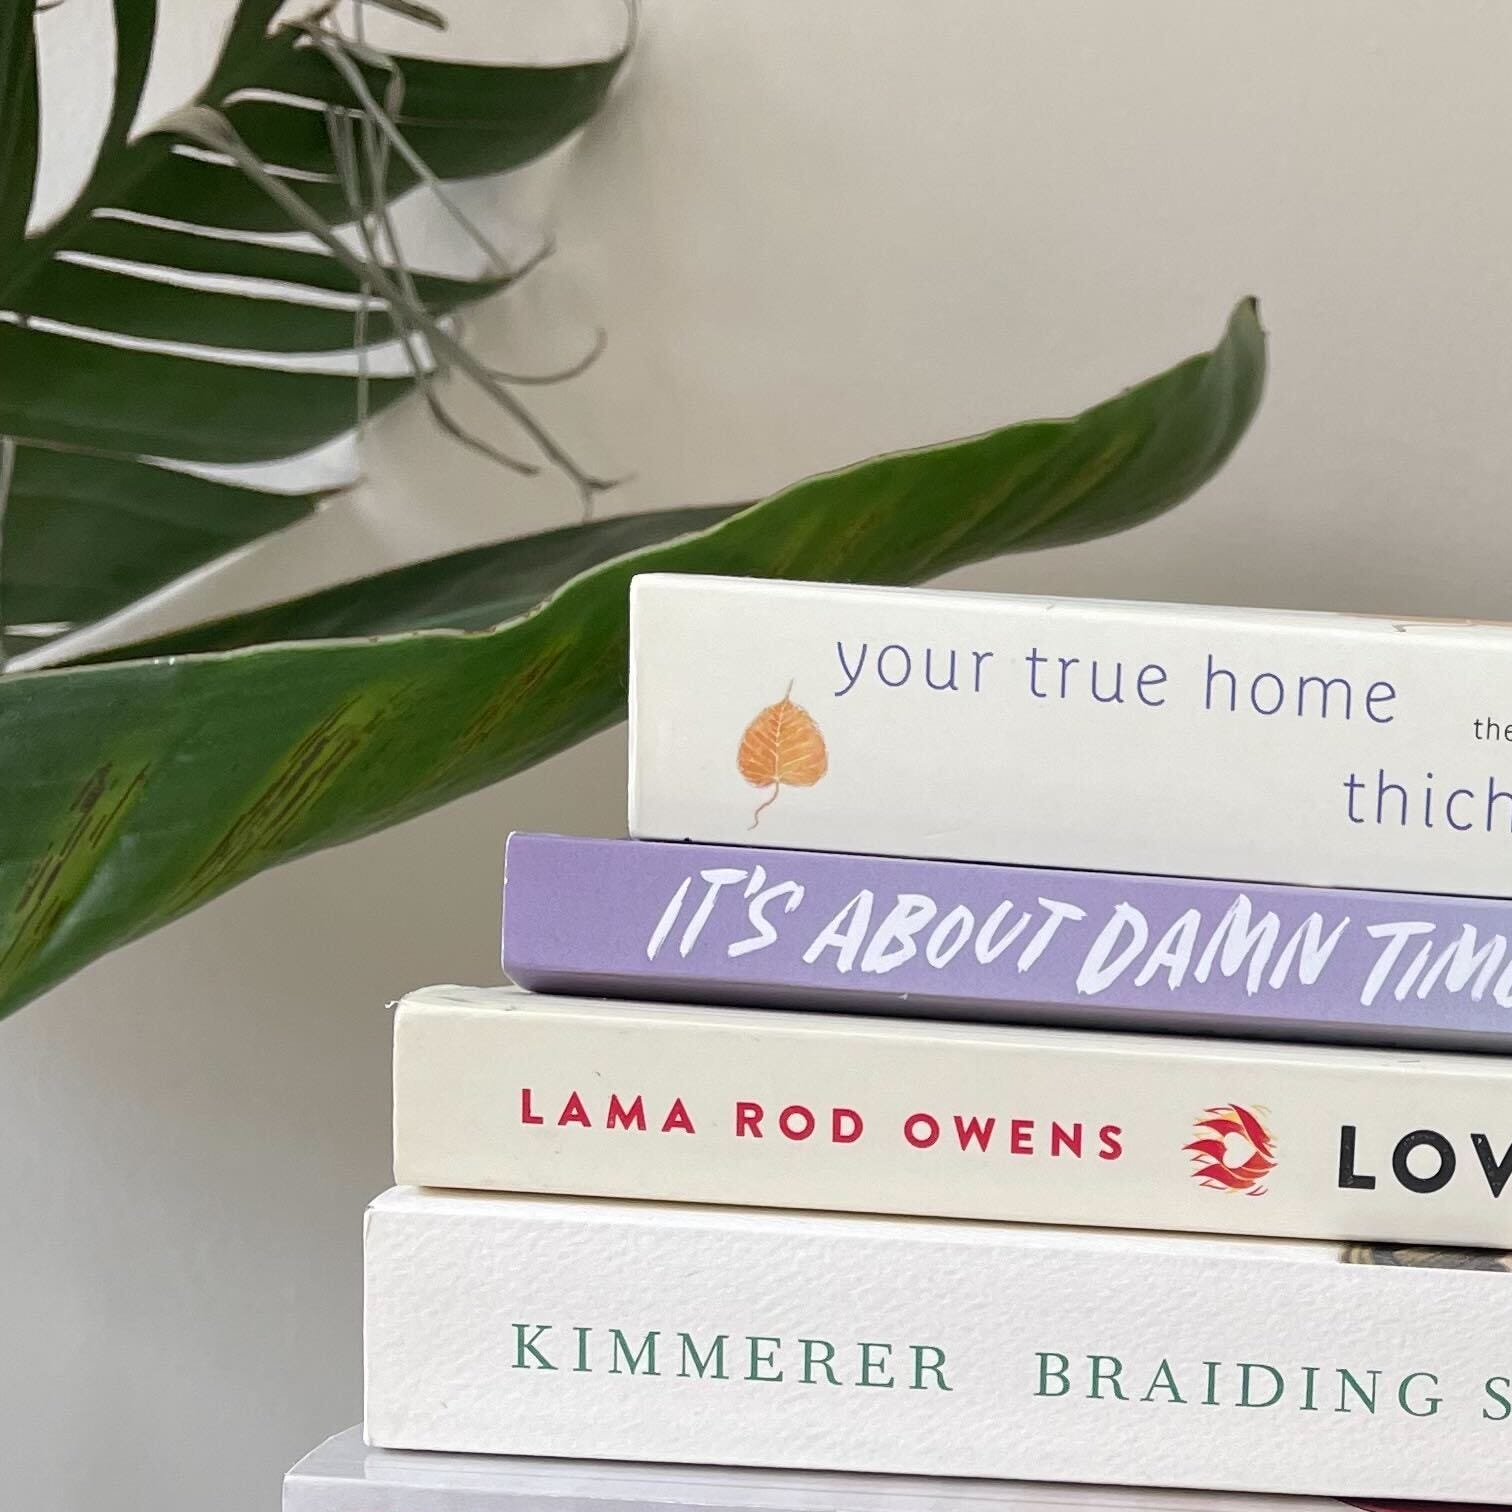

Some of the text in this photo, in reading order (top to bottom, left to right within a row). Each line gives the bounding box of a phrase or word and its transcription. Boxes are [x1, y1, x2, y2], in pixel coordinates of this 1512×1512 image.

[835, 642, 1396, 723] your true home
[647, 865, 804, 960] IT'S
[803, 889, 1085, 974] ABOUT
[1077, 894, 1350, 996] DAMN
[522, 1089, 1122, 1160] LAMA ROD OWENS
[512, 1324, 953, 1391] KIMMERER
[1034, 1352, 1443, 1416] BRAIDING
